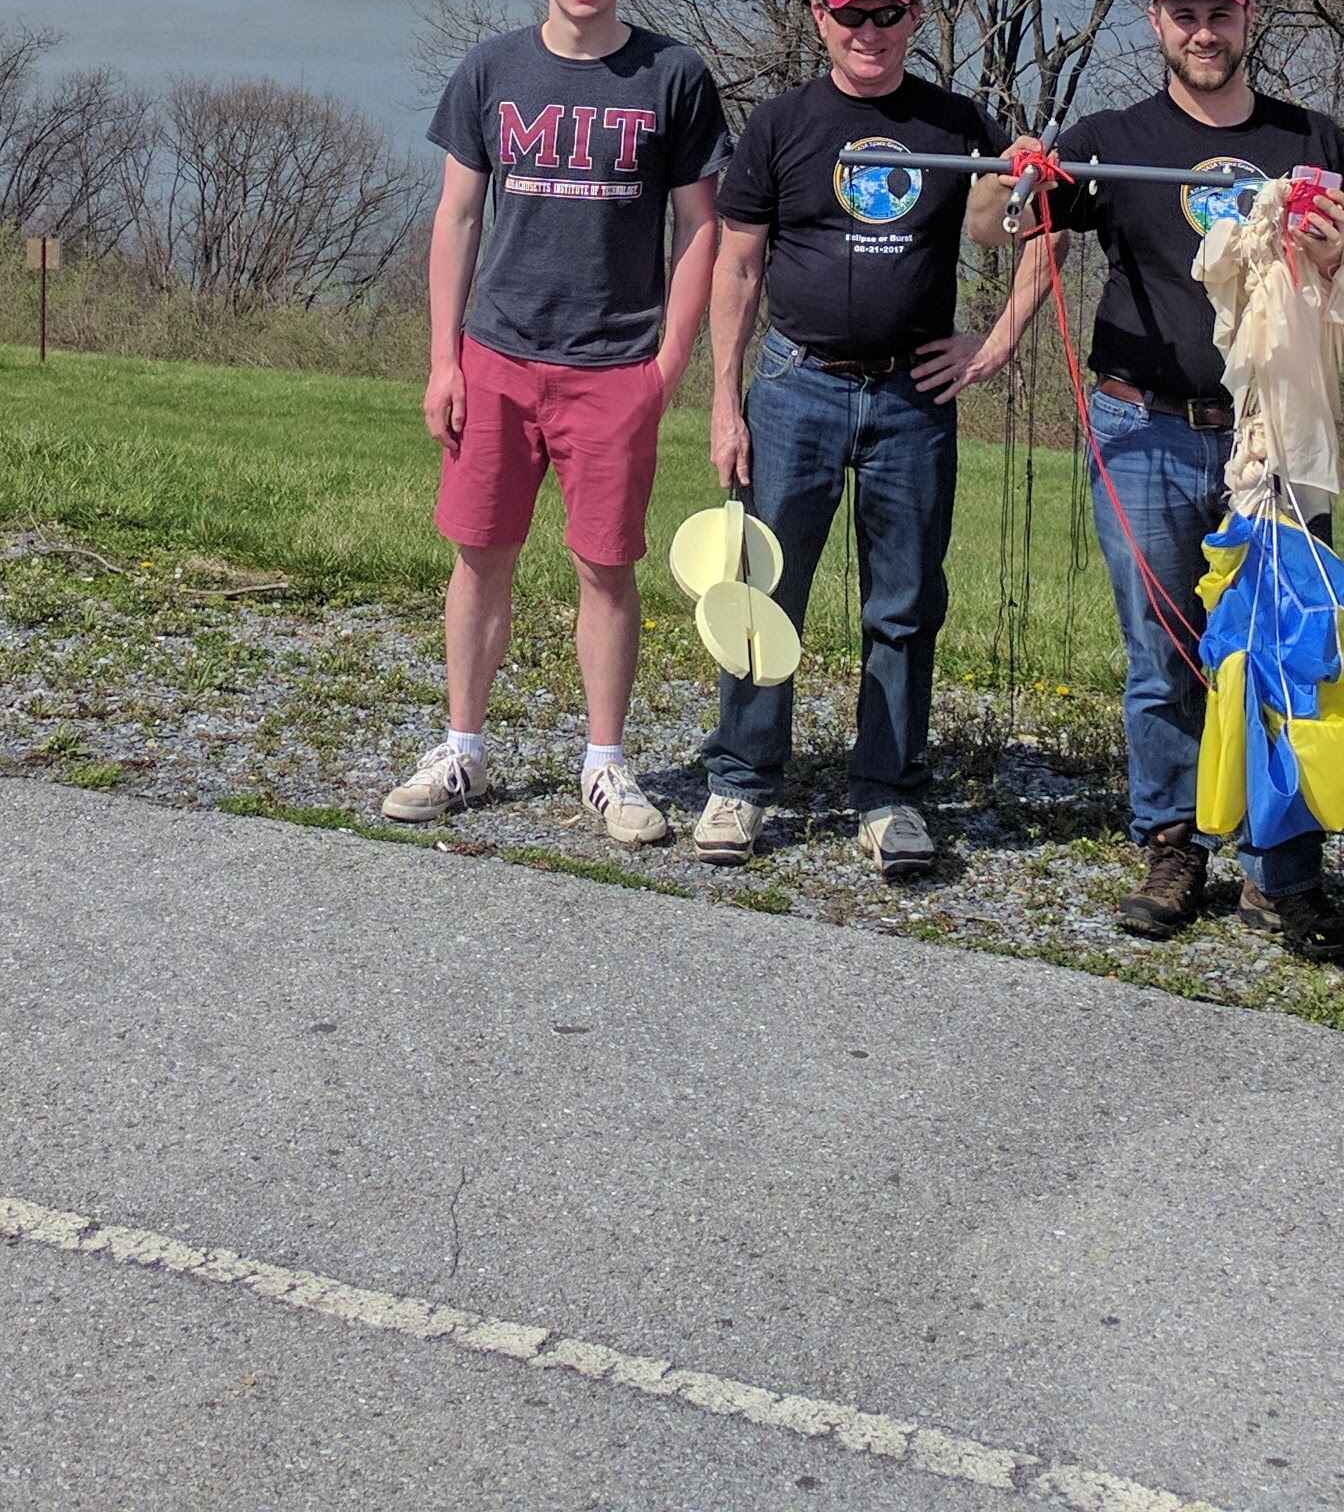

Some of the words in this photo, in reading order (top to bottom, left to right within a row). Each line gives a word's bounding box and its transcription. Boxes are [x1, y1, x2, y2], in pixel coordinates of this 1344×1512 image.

[499, 102, 655, 172] MIT
[553, 183, 589, 196] INSTITUTE
[591, 185, 598, 196] OF
